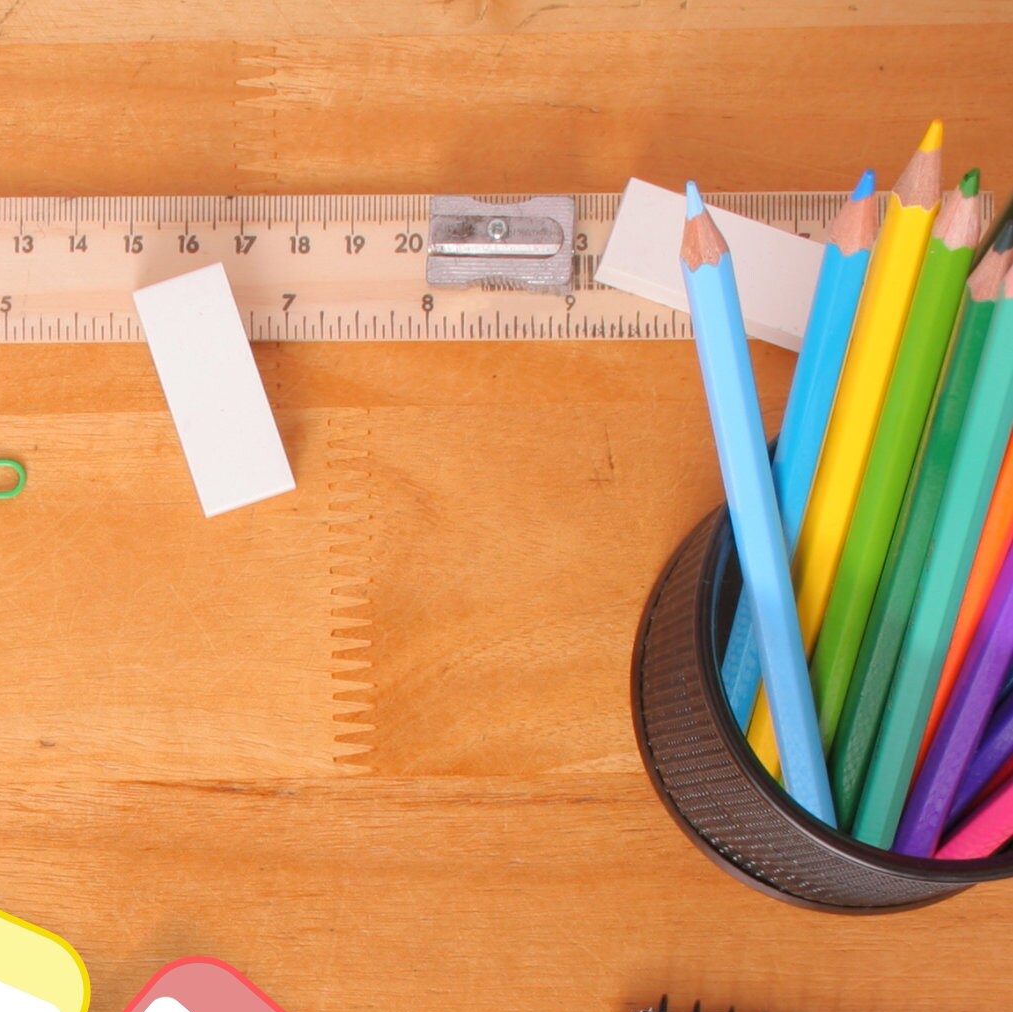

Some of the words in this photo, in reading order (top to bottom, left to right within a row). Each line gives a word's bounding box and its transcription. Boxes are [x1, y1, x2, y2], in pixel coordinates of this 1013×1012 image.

[13, 234, 35, 254] 13
[68, 234, 89, 253] 14
[123, 234, 144, 255] 15
[178, 234, 201, 255] 16
[233, 234, 257, 255] 17
[289, 235, 311, 255] 18
[344, 234, 366, 255] 19
[394, 233, 424, 254] 20
[0, 295, 12, 314] 5
[282, 293, 296, 311] 7
[421, 293, 434, 312] 8
[564, 294, 576, 312] 9
